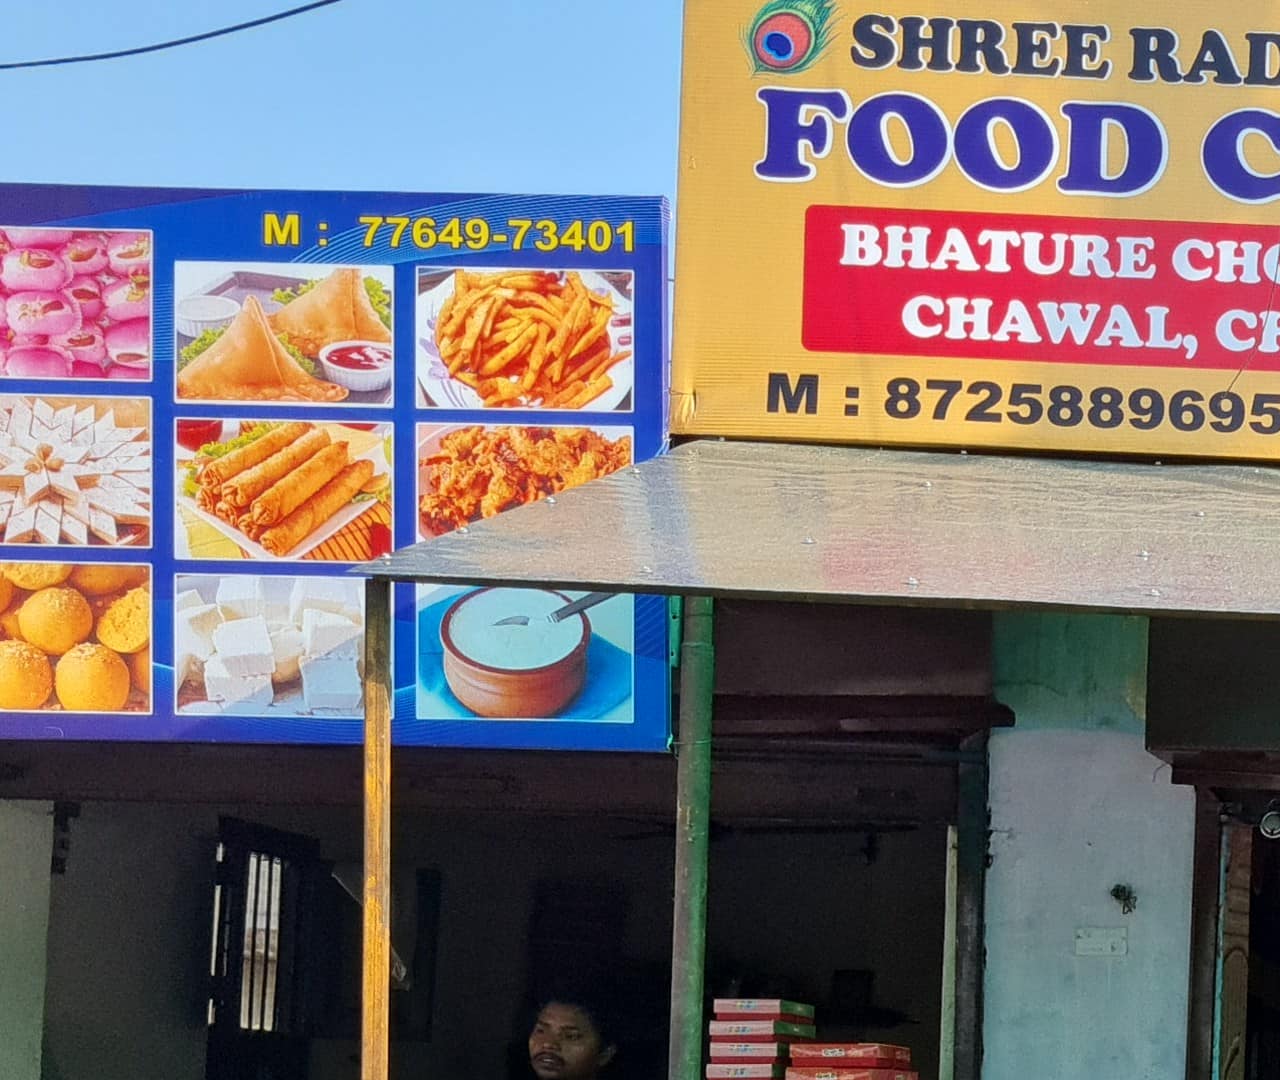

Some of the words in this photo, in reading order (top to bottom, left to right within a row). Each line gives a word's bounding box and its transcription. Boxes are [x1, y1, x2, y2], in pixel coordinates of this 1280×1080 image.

[850, 14, 1112, 79] SHREE
[754, 86, 1169, 196] FOOD
[264, 214, 301, 246] M
[359, 215, 636, 253] 77649-73401
[839, 223, 1157, 280] BHATURE
[901, 295, 1198, 360] CHAWAL,
[767, 373, 819, 416] M
